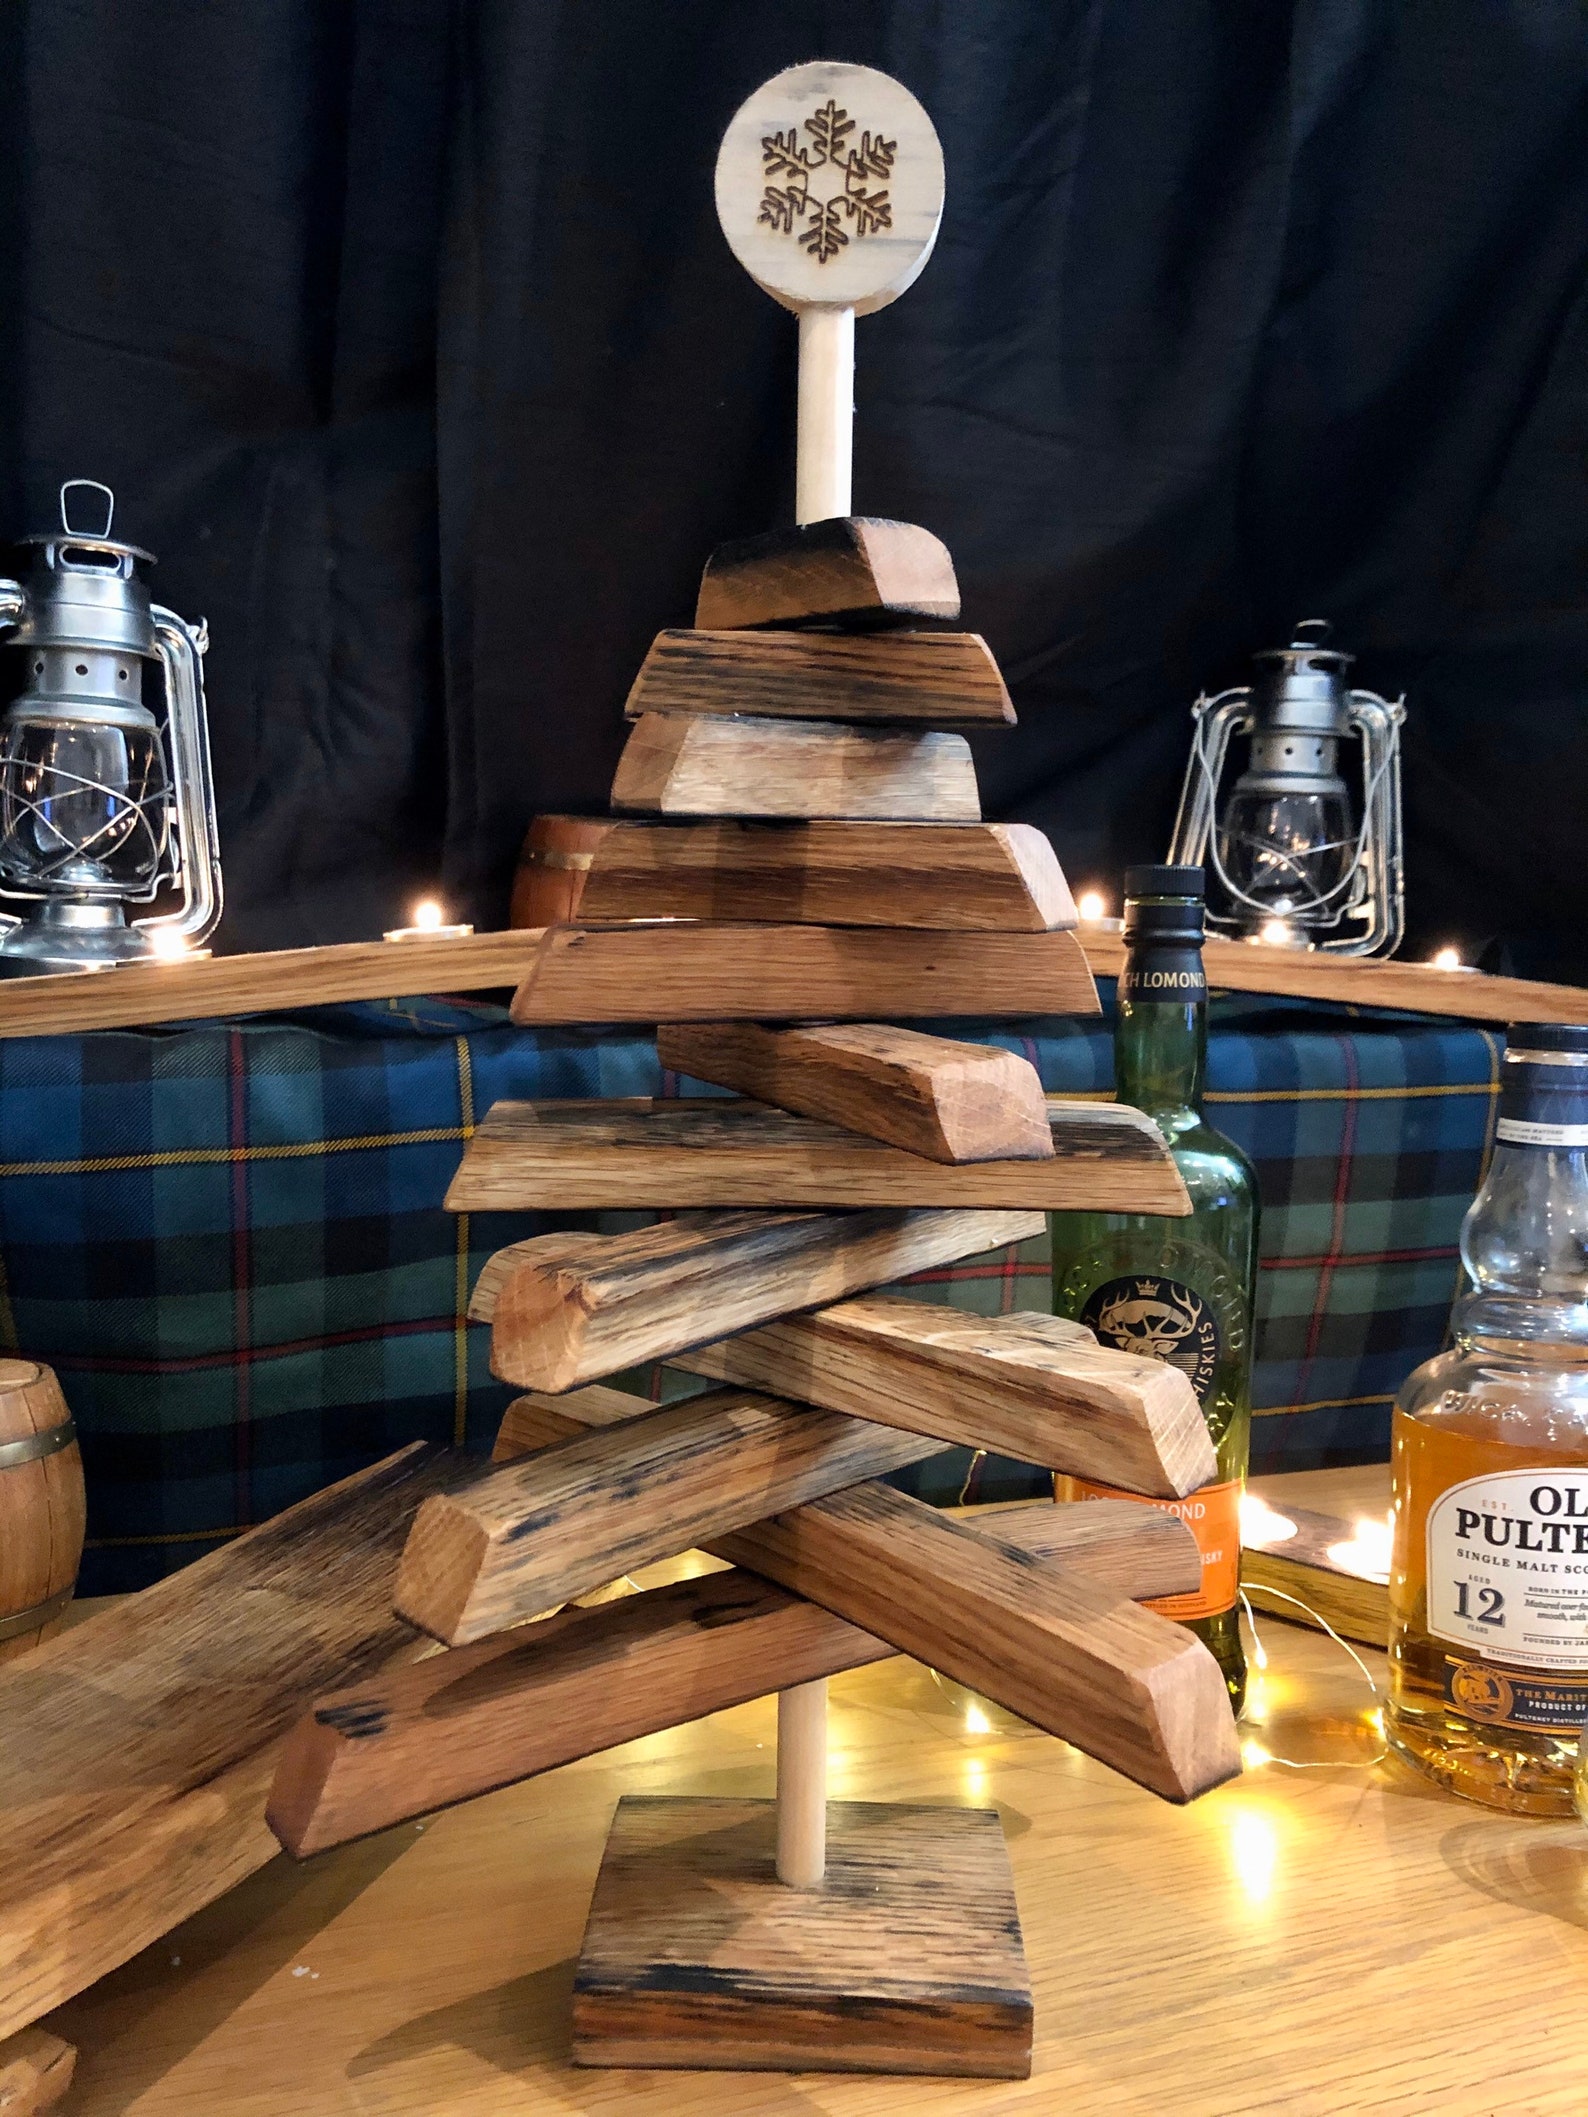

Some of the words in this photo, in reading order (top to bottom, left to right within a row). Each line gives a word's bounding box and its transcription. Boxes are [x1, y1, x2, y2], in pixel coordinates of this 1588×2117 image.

[1144, 972, 1206, 988] LOMOND
[1193, 1321, 1216, 1401] HISKIES
[1457, 1548, 1511, 1567] SINGLE
[1516, 1560, 1559, 1573] MALT
[1468, 1574, 1491, 1585] AGED
[1453, 1580, 1506, 1628] 12
[1516, 1688, 1542, 1699] THE
[1529, 1701, 1573, 1712] PRODUCT
